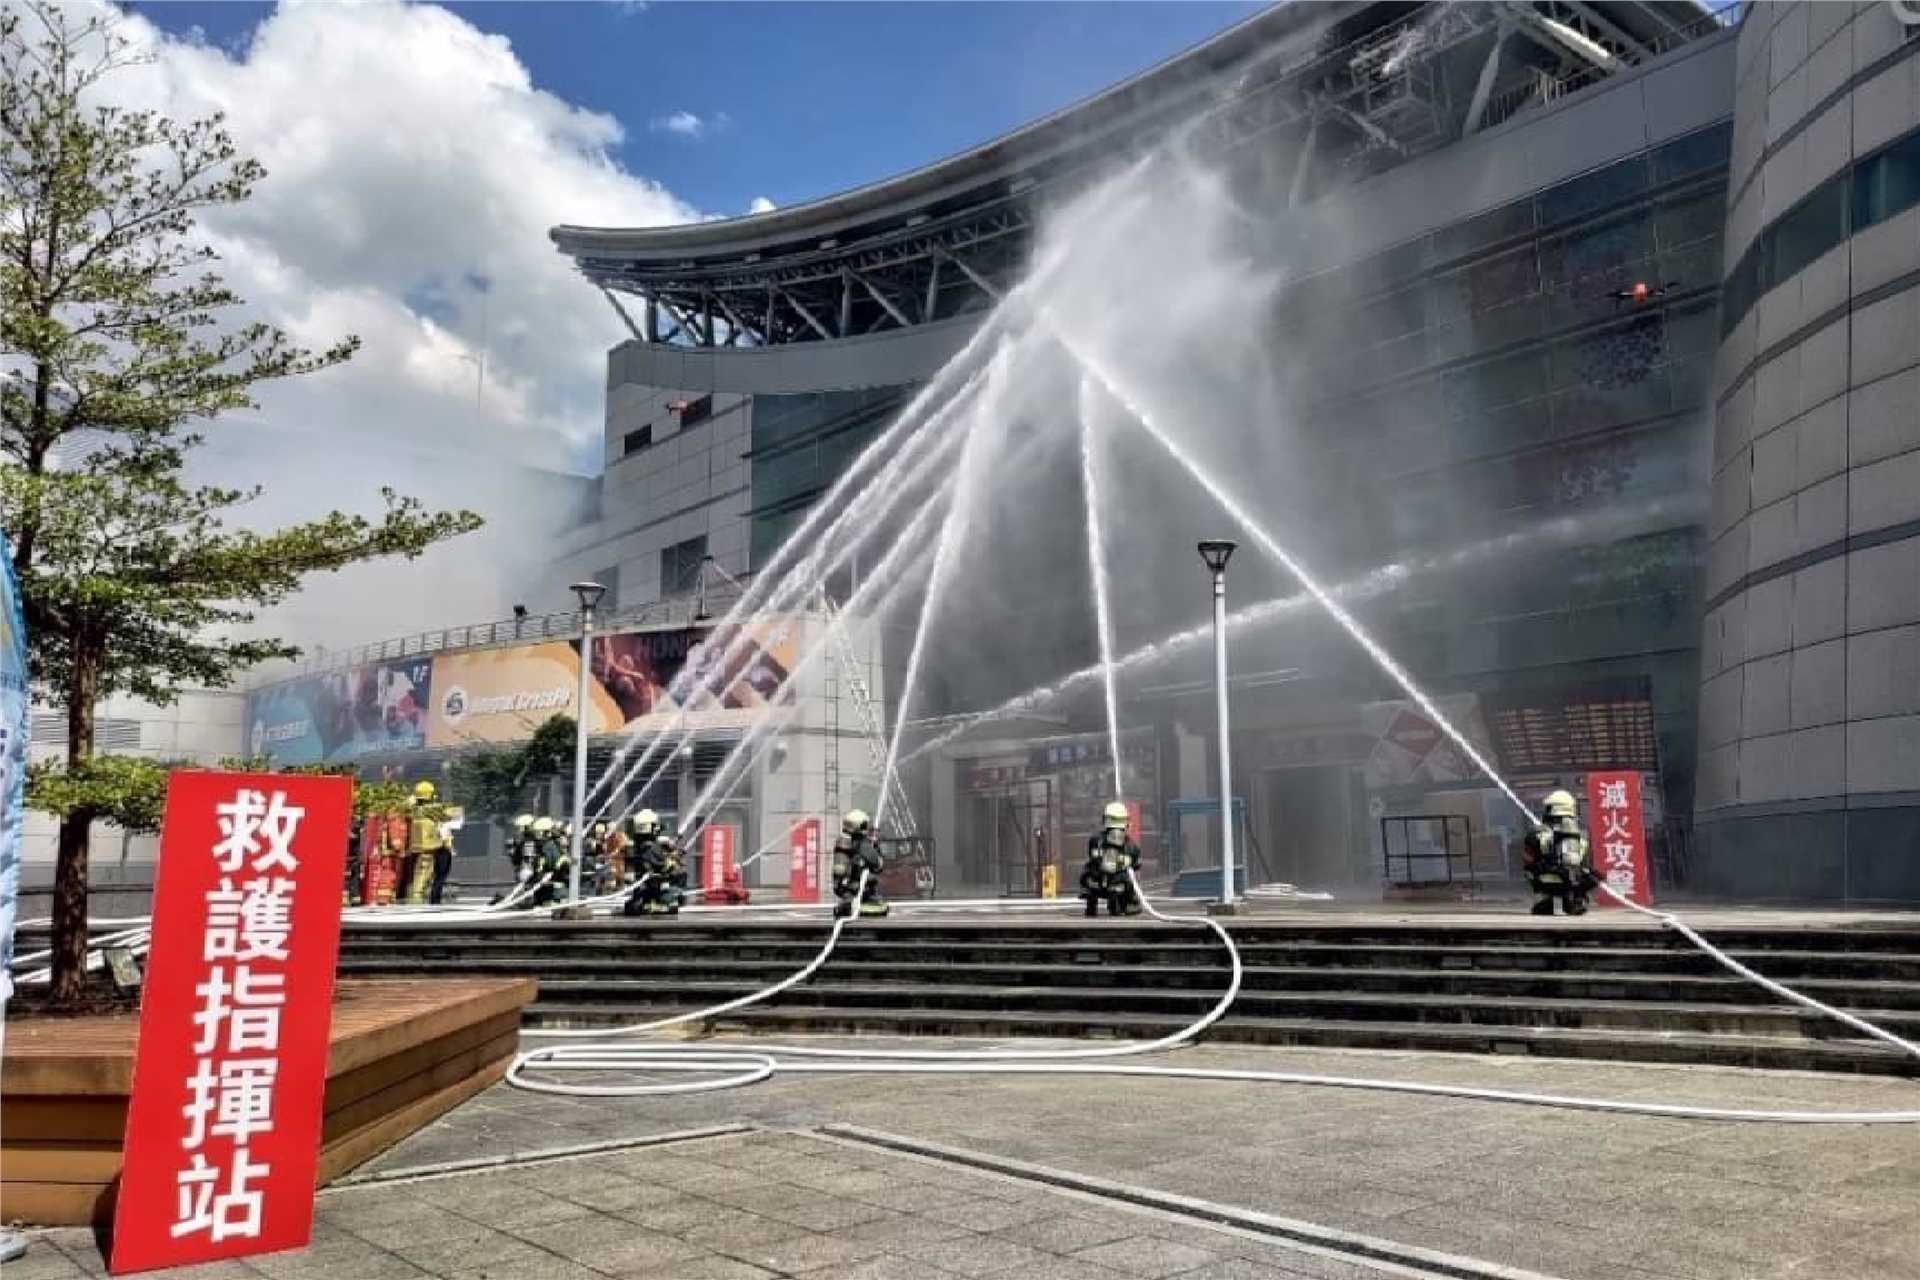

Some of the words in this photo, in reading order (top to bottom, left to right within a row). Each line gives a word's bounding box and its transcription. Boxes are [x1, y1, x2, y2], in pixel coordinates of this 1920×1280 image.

[170, 789, 305, 1243] 救護指揮站
